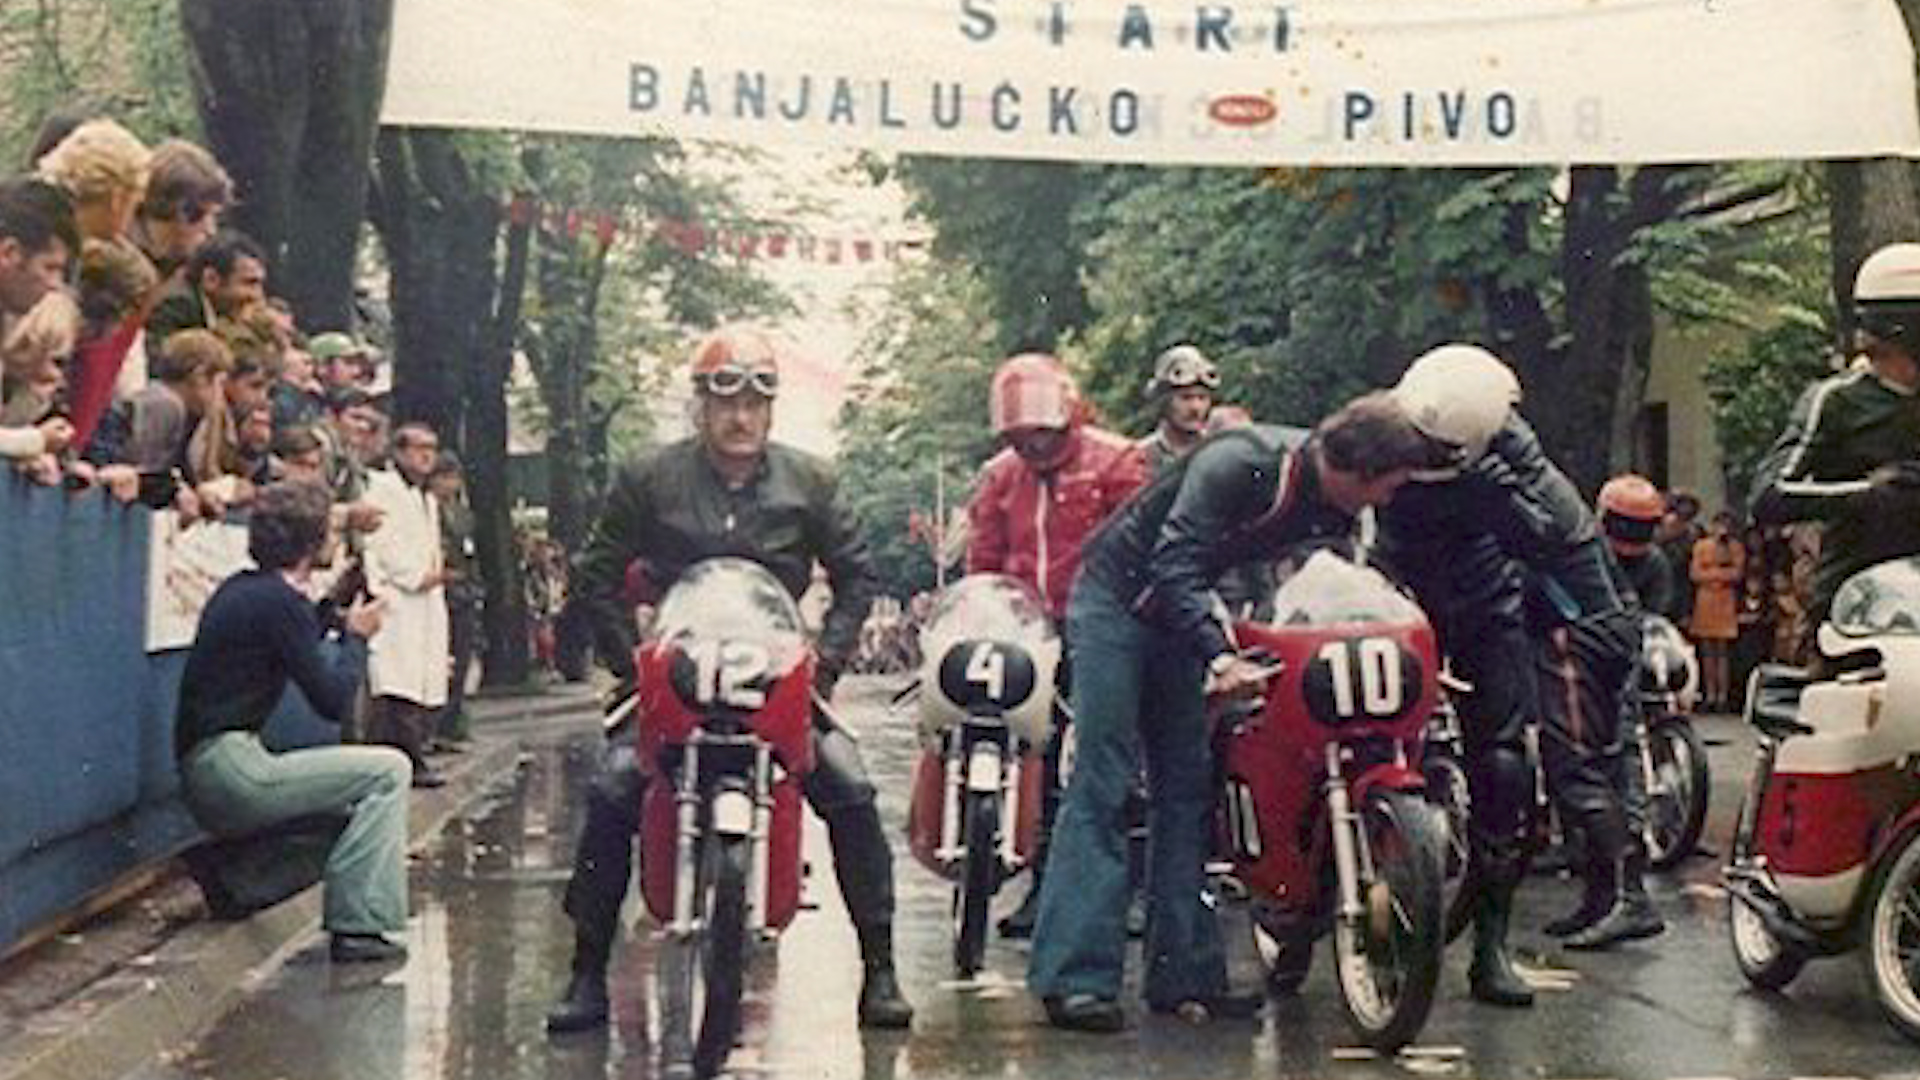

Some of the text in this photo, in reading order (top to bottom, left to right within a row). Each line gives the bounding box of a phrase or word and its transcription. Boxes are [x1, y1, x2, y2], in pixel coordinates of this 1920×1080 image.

[1345, 91, 1516, 141] PIVO
[693, 640, 766, 707] 12
[964, 642, 1005, 700] 4
[1318, 636, 1403, 717] 10
